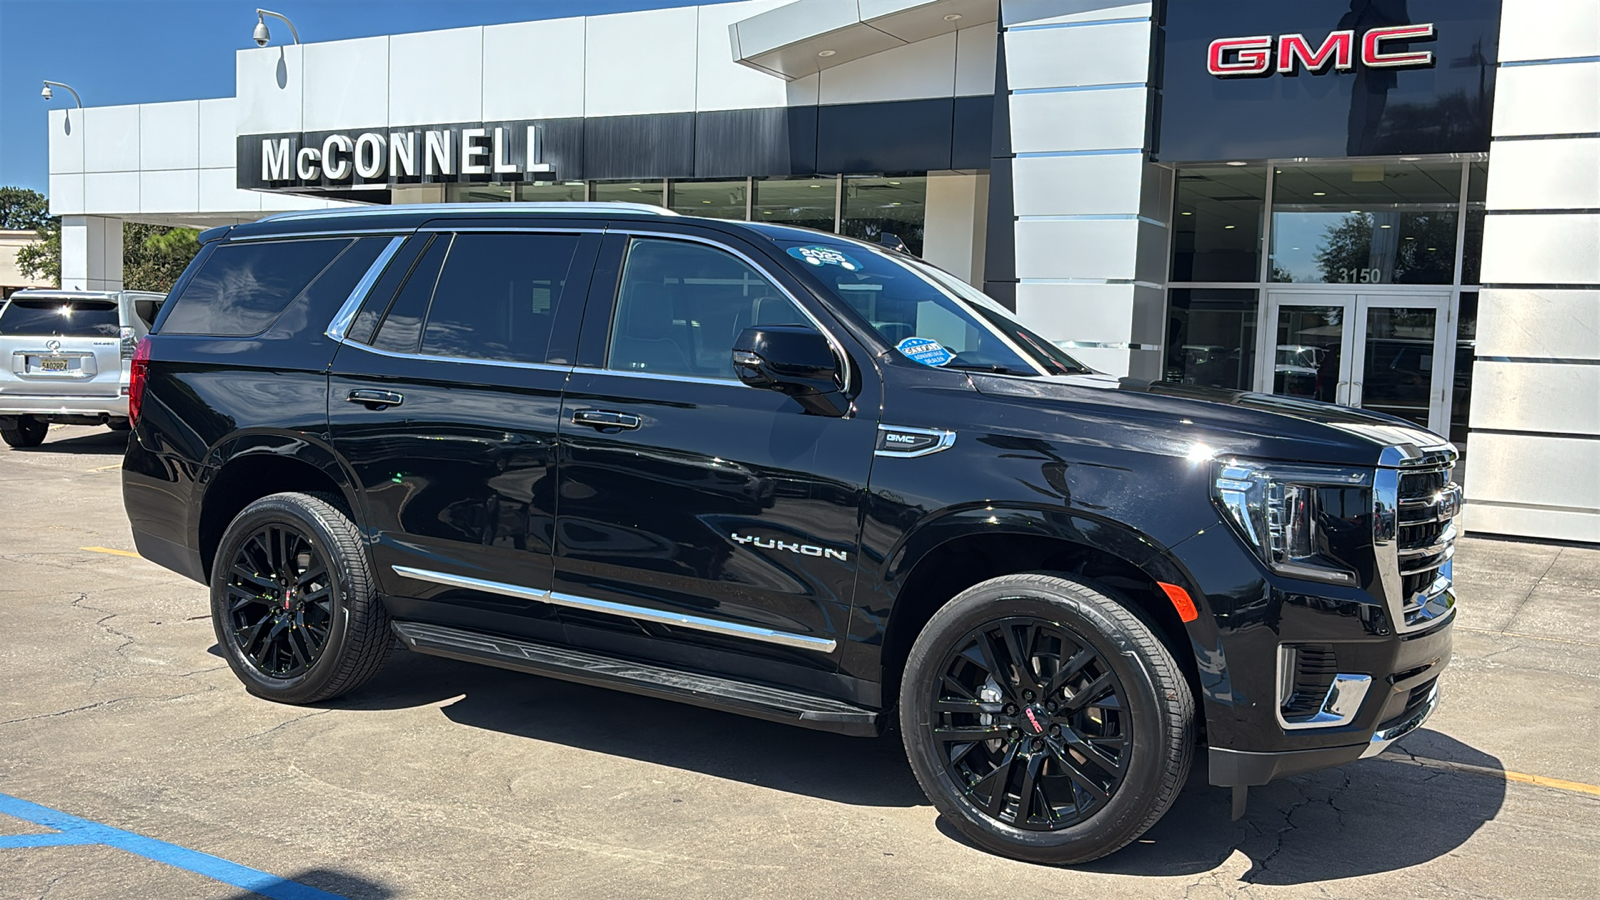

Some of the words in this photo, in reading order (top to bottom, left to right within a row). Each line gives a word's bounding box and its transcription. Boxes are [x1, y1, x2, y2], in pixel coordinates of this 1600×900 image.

[1207, 23, 1434, 75] GMC
[262, 125, 551, 181] McCONNELL
[1338, 268, 1381, 284] 3150
[887, 433, 915, 443] GMC
[731, 533, 847, 561] YUKON
[1025, 708, 1043, 733] GMC
